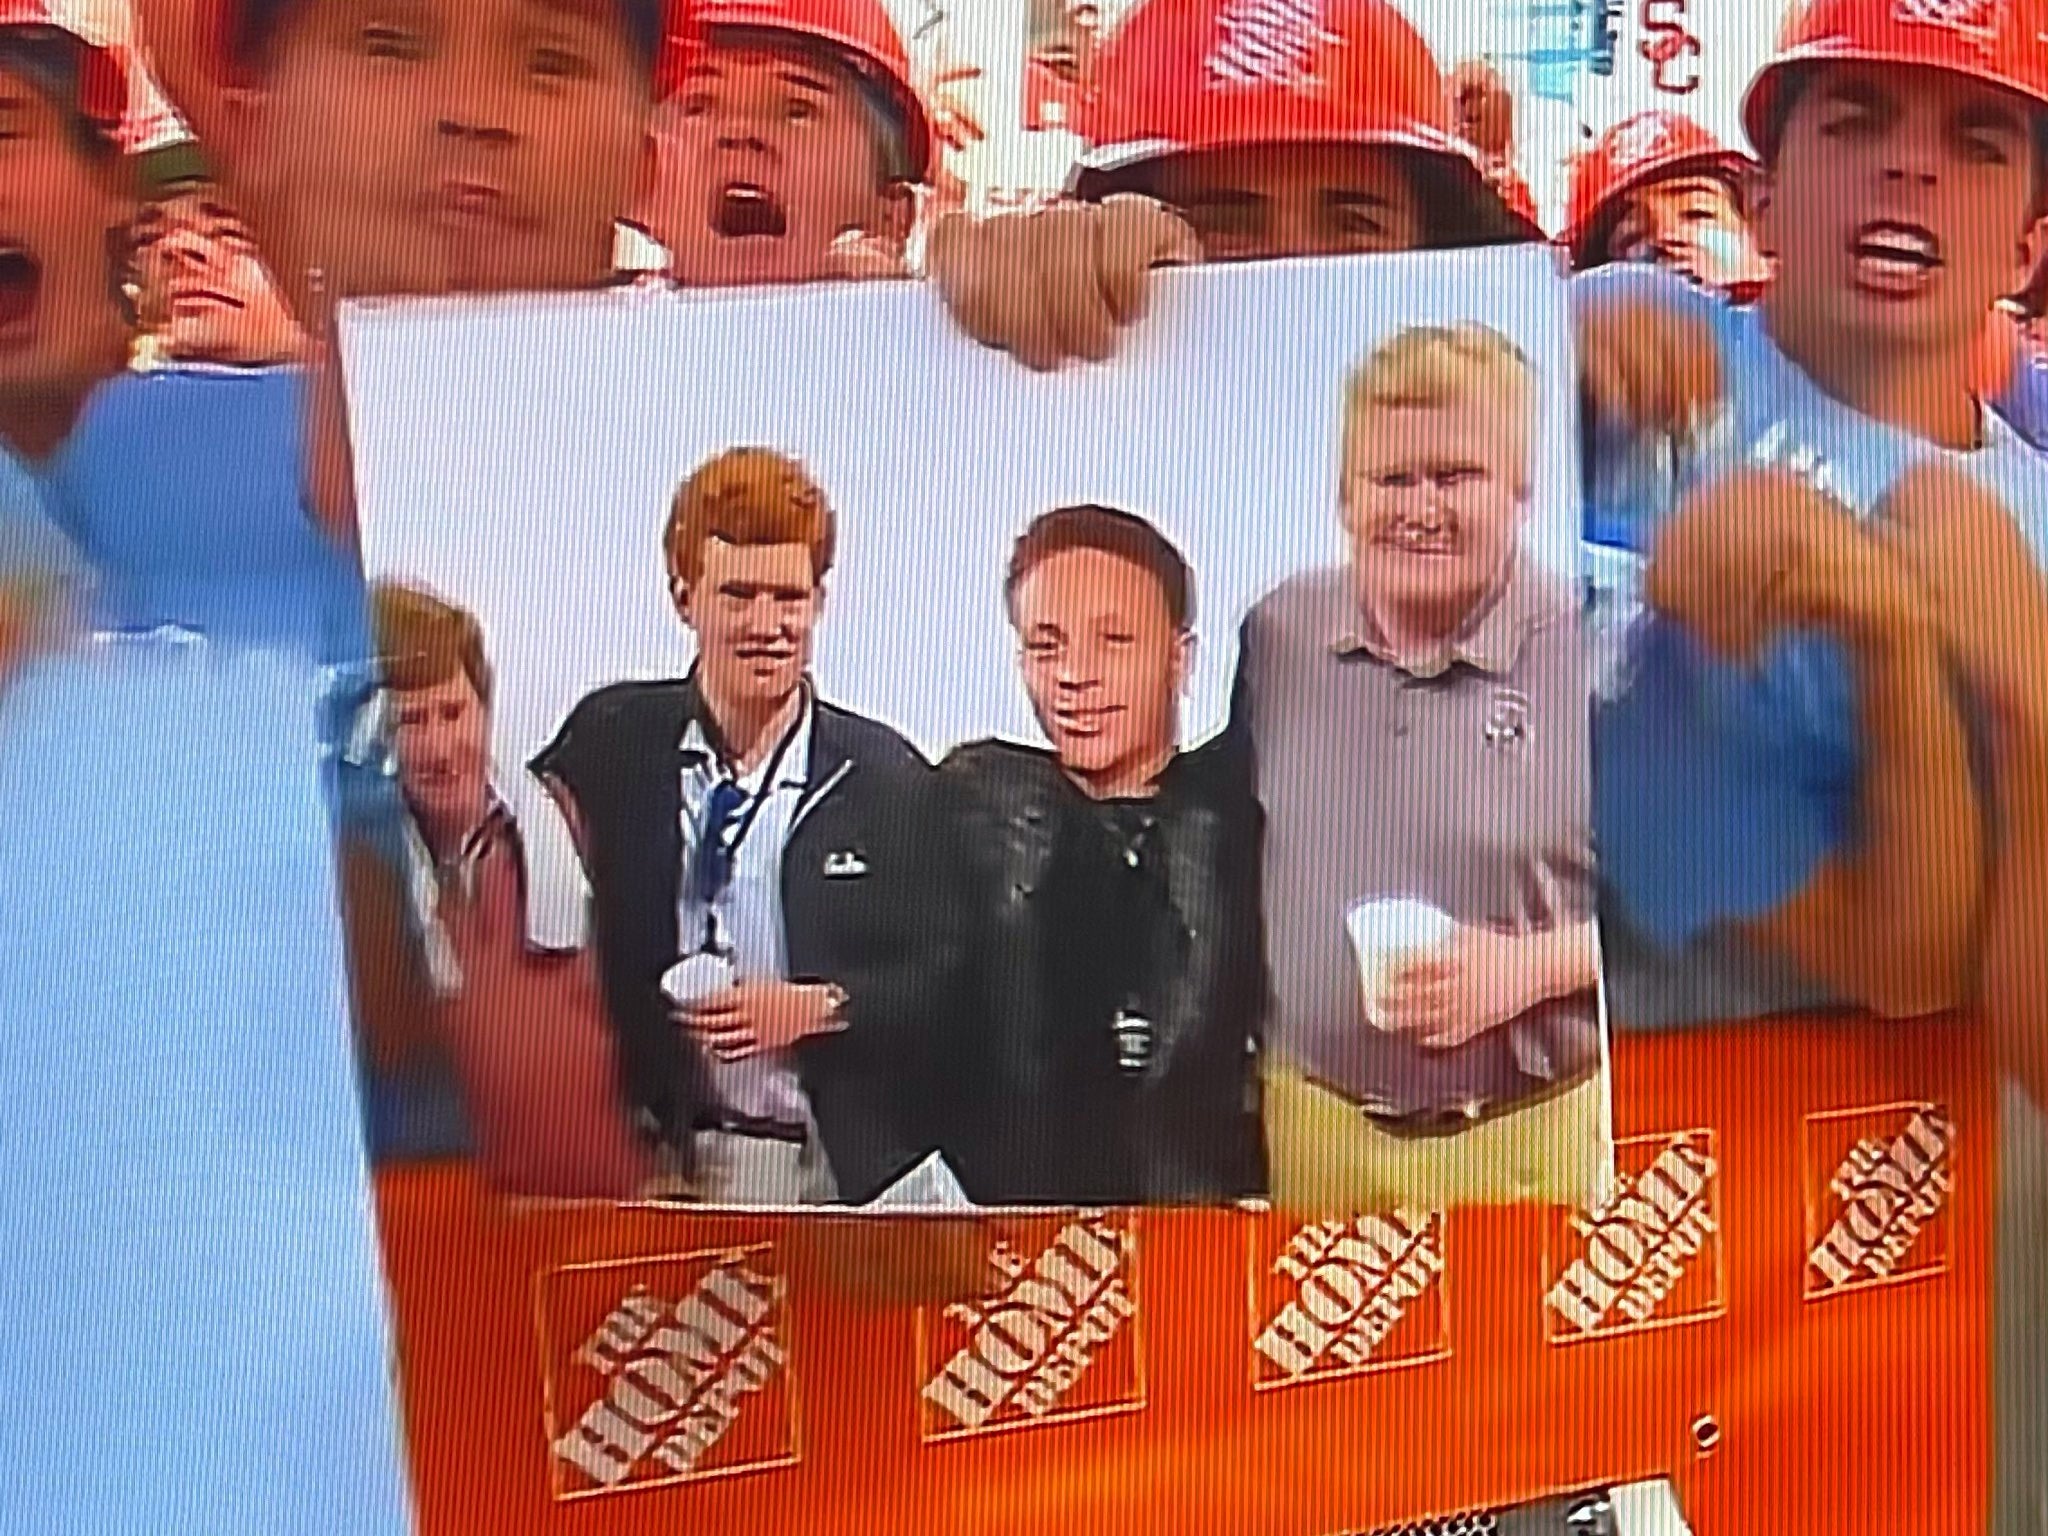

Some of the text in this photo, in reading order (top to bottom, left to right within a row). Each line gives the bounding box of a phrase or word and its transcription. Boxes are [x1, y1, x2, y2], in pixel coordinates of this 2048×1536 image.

[1543, 1134, 1717, 1330] HOME
[1809, 1104, 1956, 1285] HOME
[553, 1249, 787, 1486] HOME
[921, 1211, 1136, 1428] HOME
